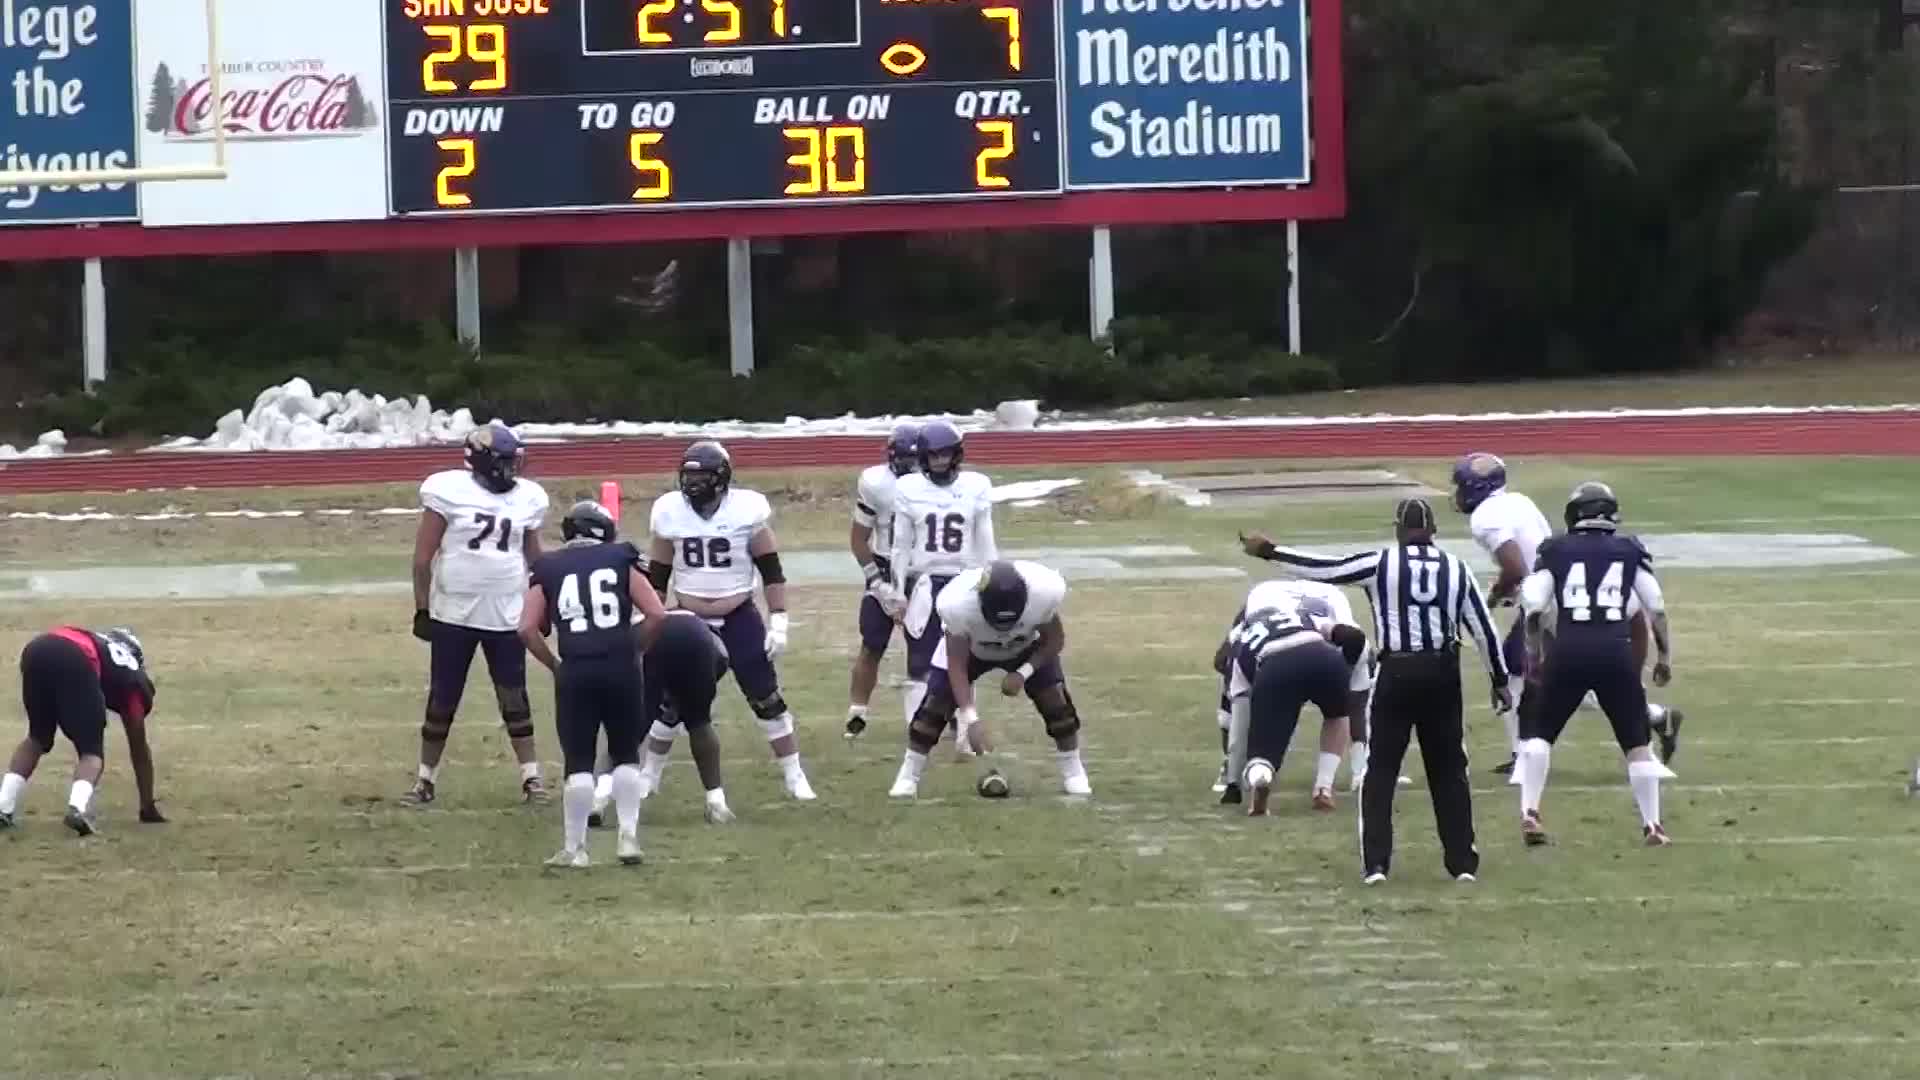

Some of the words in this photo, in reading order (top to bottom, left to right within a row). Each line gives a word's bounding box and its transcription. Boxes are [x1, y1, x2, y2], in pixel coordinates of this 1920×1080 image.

[423, 25, 506, 91] 29
[981, 7, 1020, 71] 7
[1076, 26, 1291, 86] Meredith
[12, 66, 85, 117] the
[174, 73, 347, 137] Coca-Cola
[579, 103, 617, 130] TO
[631, 101, 675, 127] GO
[754, 98, 833, 124] BALL
[847, 96, 890, 121] ON
[955, 90, 1031, 118] QTR.
[404, 107, 505, 136] DOWN
[1090, 99, 1281, 158] Stadium
[437, 138, 475, 205] 2
[631, 133, 671, 199] 5
[783, 127, 865, 194] 30
[975, 121, 1014, 187] 2
[468, 512, 512, 551] 71
[682, 537, 732, 568] 82
[925, 512, 965, 552] 16
[558, 568, 620, 633] 46
[1407, 558, 1440, 603] U
[1563, 561, 1625, 621] 44
